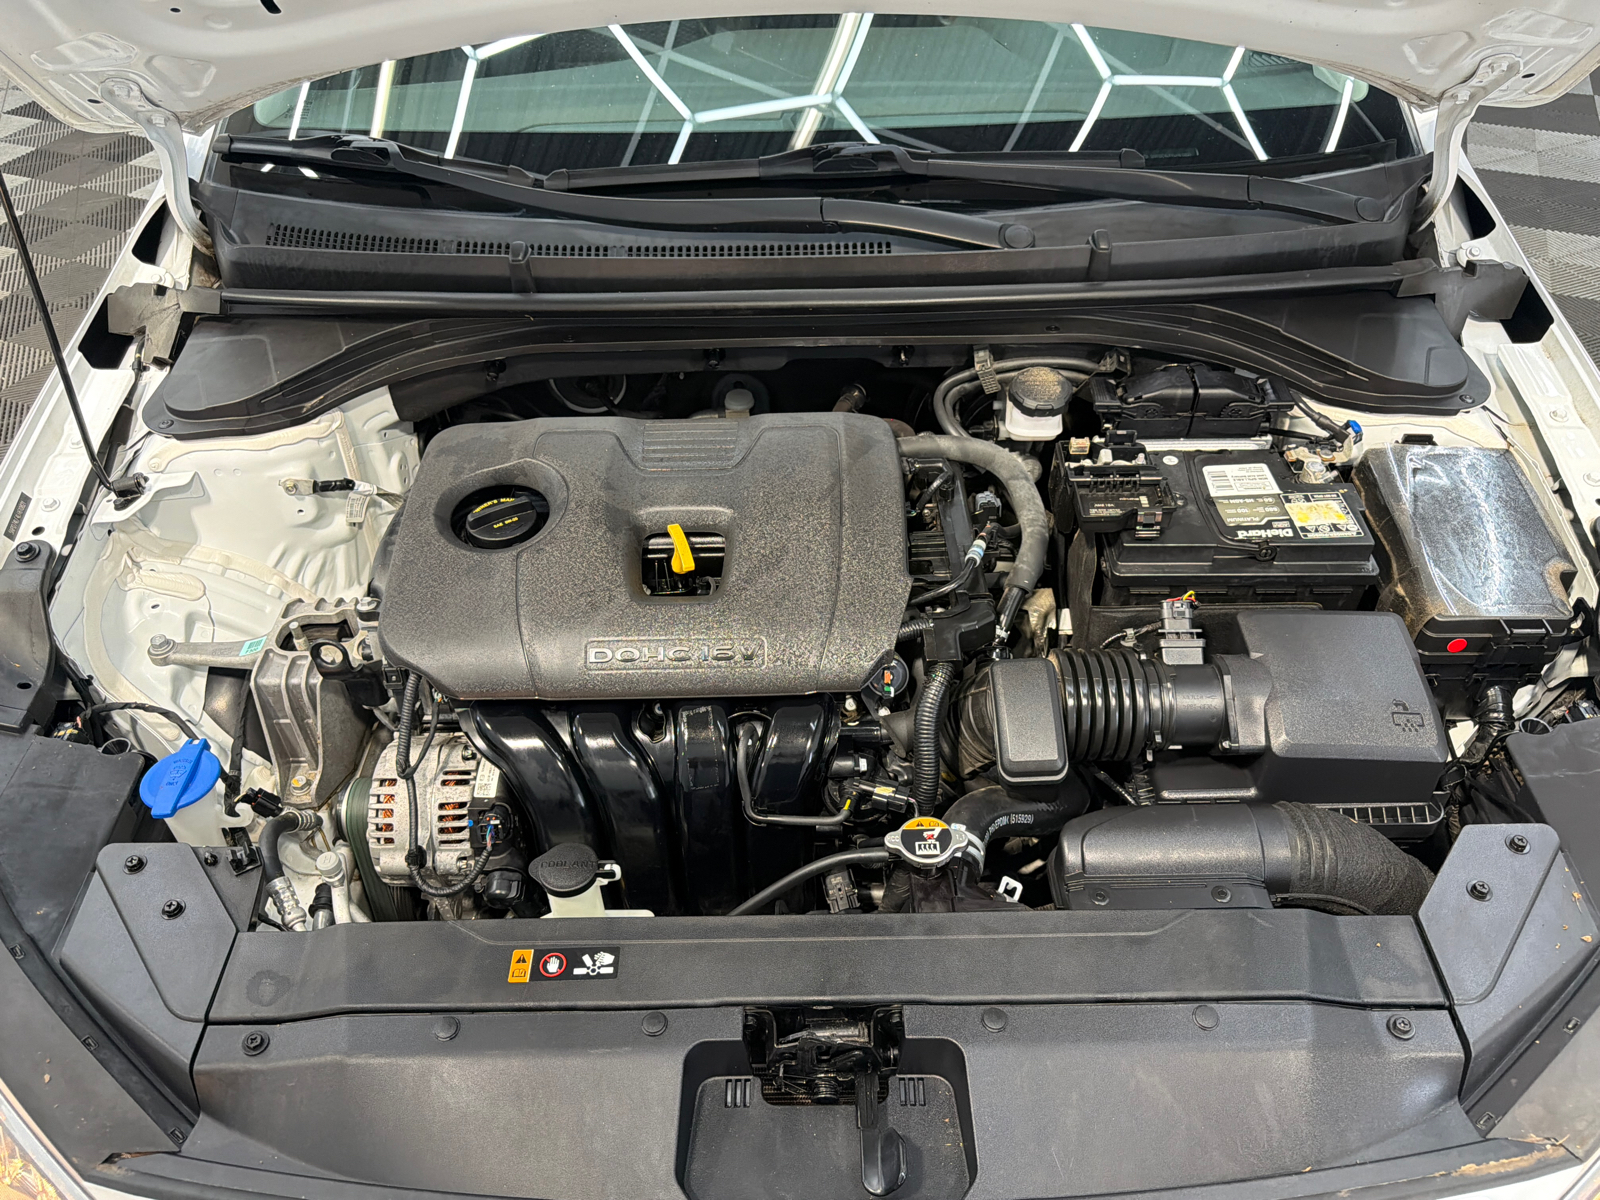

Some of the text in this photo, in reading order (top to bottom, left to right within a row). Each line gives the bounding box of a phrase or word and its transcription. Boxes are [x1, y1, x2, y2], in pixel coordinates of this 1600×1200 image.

[472, 499, 498, 513] WNER'S
[1236, 528, 1293, 539] DieHard
[588, 645, 762, 664] DOHC 16V
[541, 860, 597, 869] COOLANT
